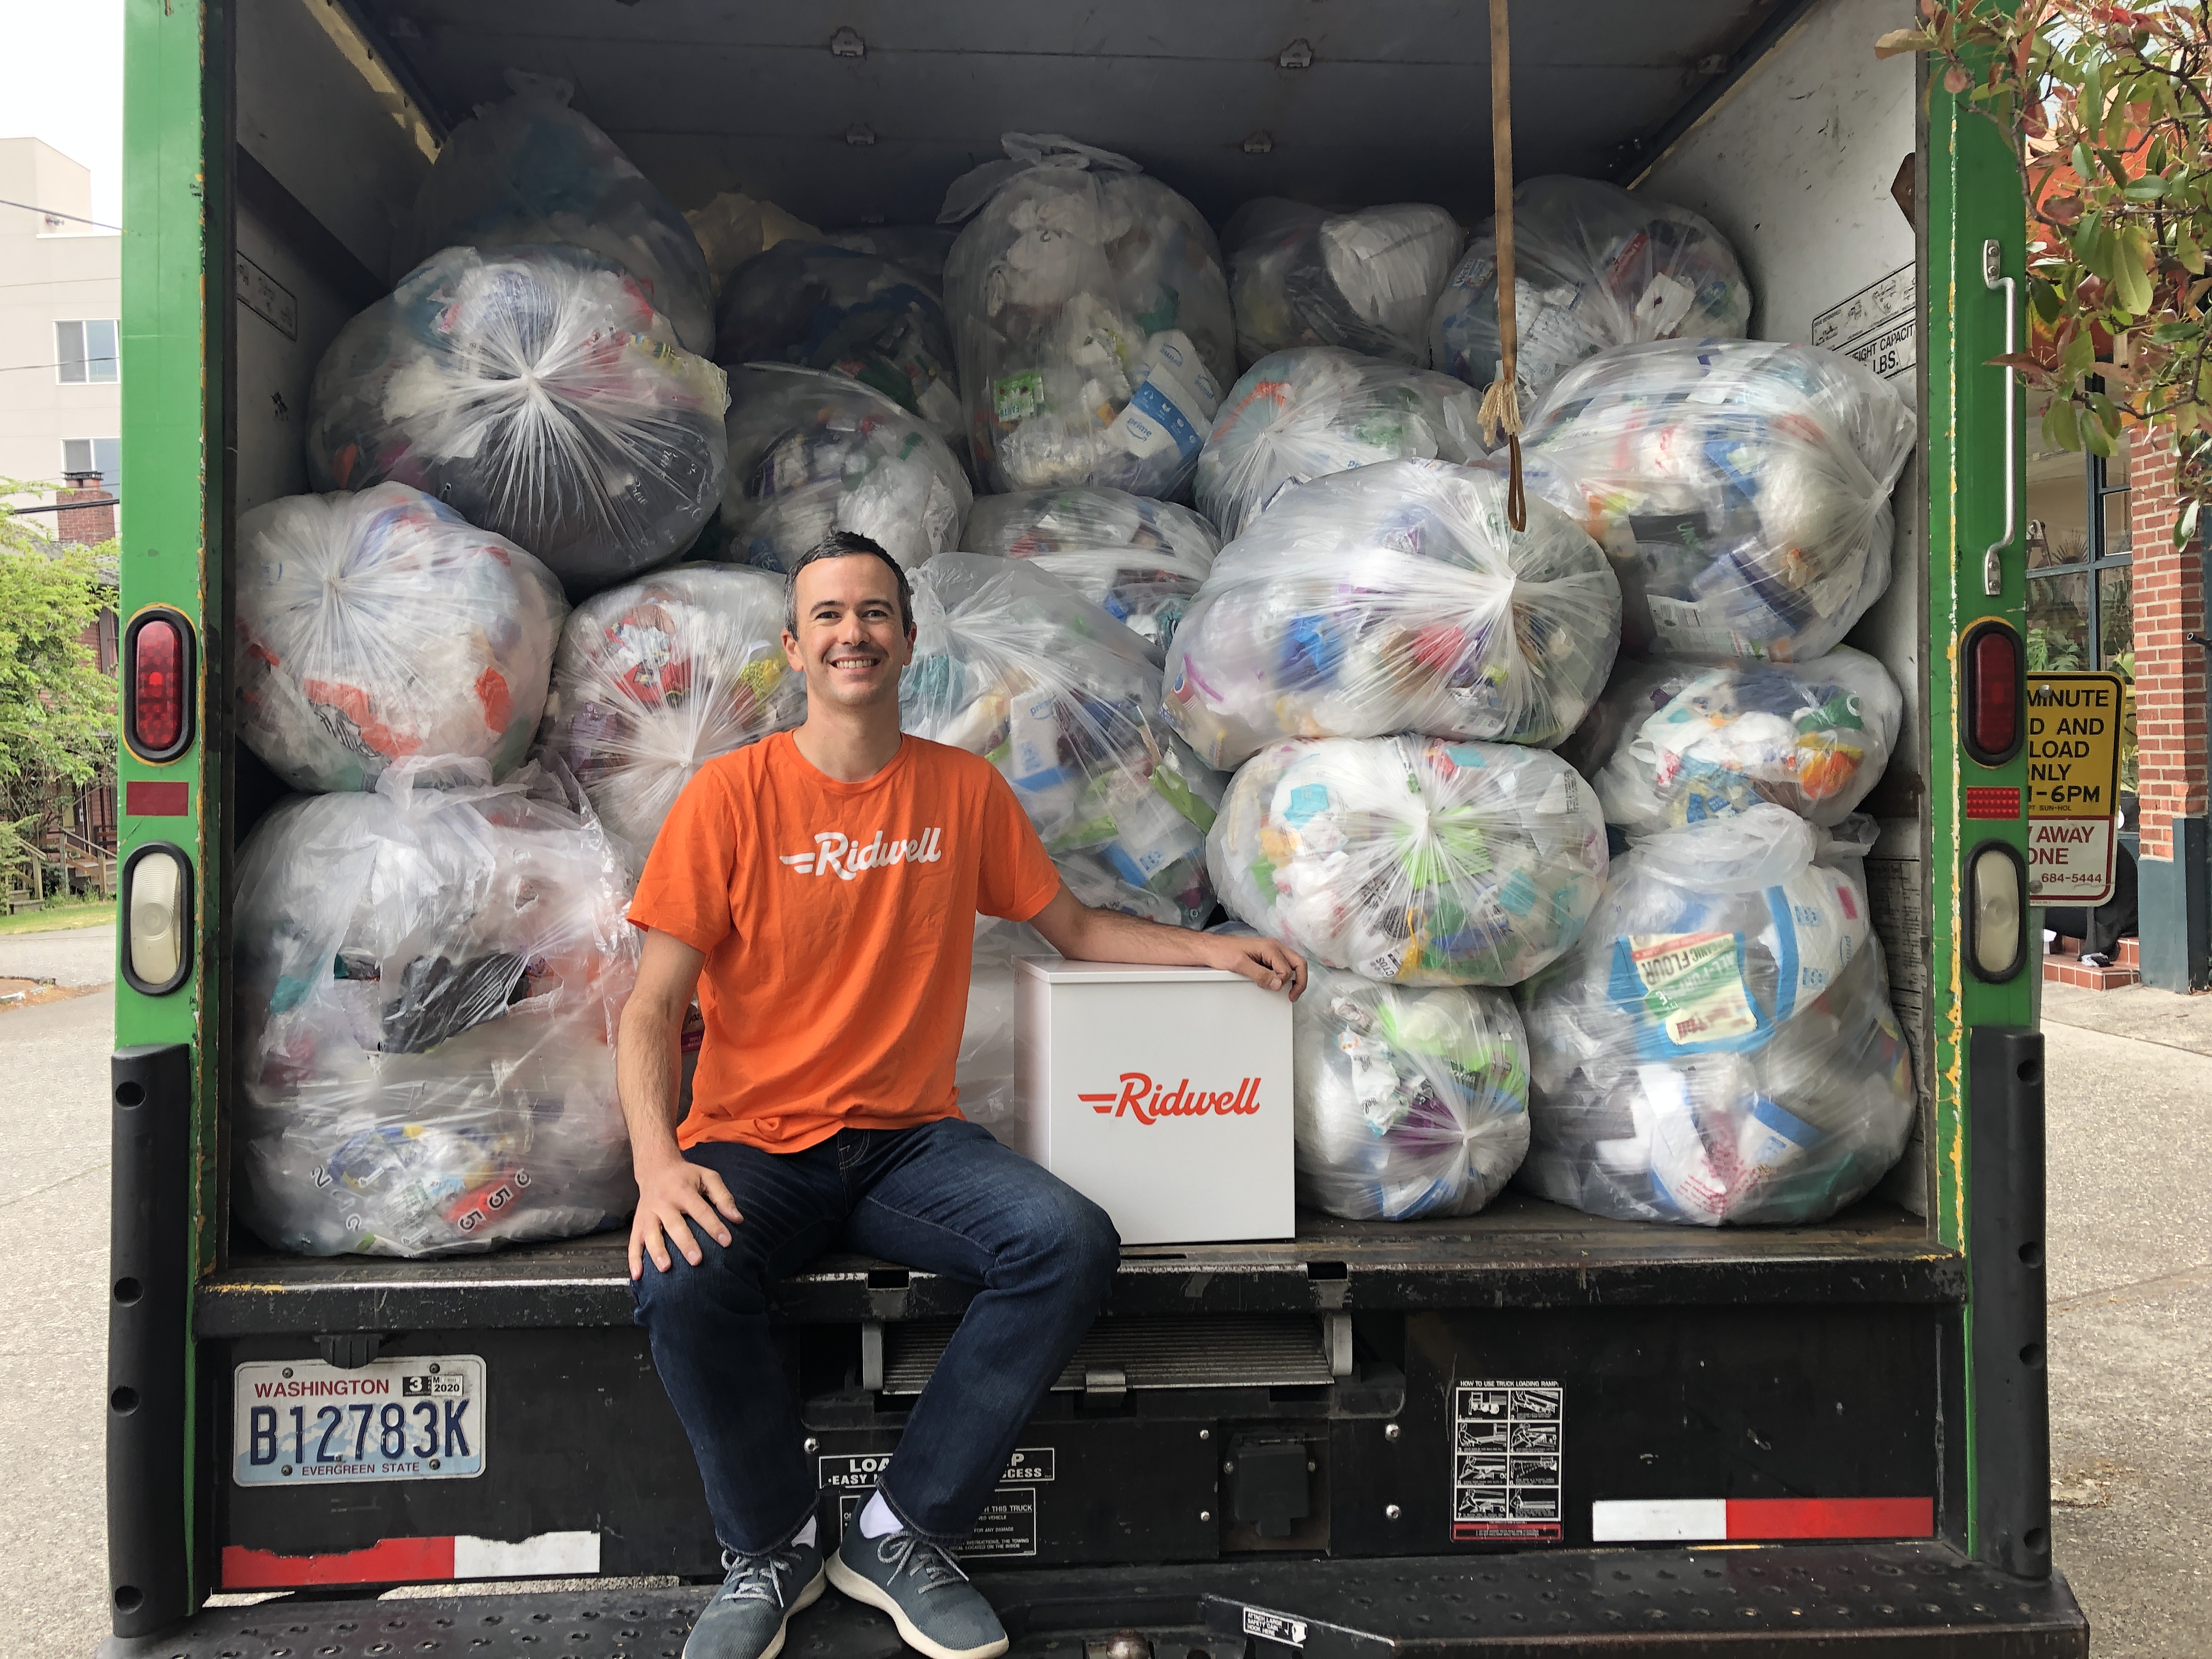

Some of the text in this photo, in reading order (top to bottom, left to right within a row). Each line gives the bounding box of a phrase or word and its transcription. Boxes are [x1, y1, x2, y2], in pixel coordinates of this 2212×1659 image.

[1880, 323, 1916, 351] CAPACIT
[1126, 417, 1153, 437] prime
[2028, 689, 2109, 707] MINUTE
[2030, 718, 2104, 735] D AND
[2029, 741, 2090, 758] LOAD
[2029, 764, 2072, 781] NLY
[2028, 785, 2100, 803] -6PM
[2036, 826, 2095, 843] AWAY
[814, 827, 942, 881] Ridwell
[2029, 848, 2069, 865] ONE
[2041, 873, 2102, 883] 684-5444
[1641, 950, 1691, 985] FLOUR
[1115, 1072, 1262, 1126] Ridwell
[255, 1379, 390, 1398] WASHINGTON
[409, 1377, 423, 1392] 3
[434, 1384, 460, 1392] 2020
[250, 1400, 470, 1465] B12783K
[302, 1462, 420, 1476] EVERGREEN STATE
[849, 1457, 890, 1473] LOA
[1002, 1468, 1042, 1479] CESS
